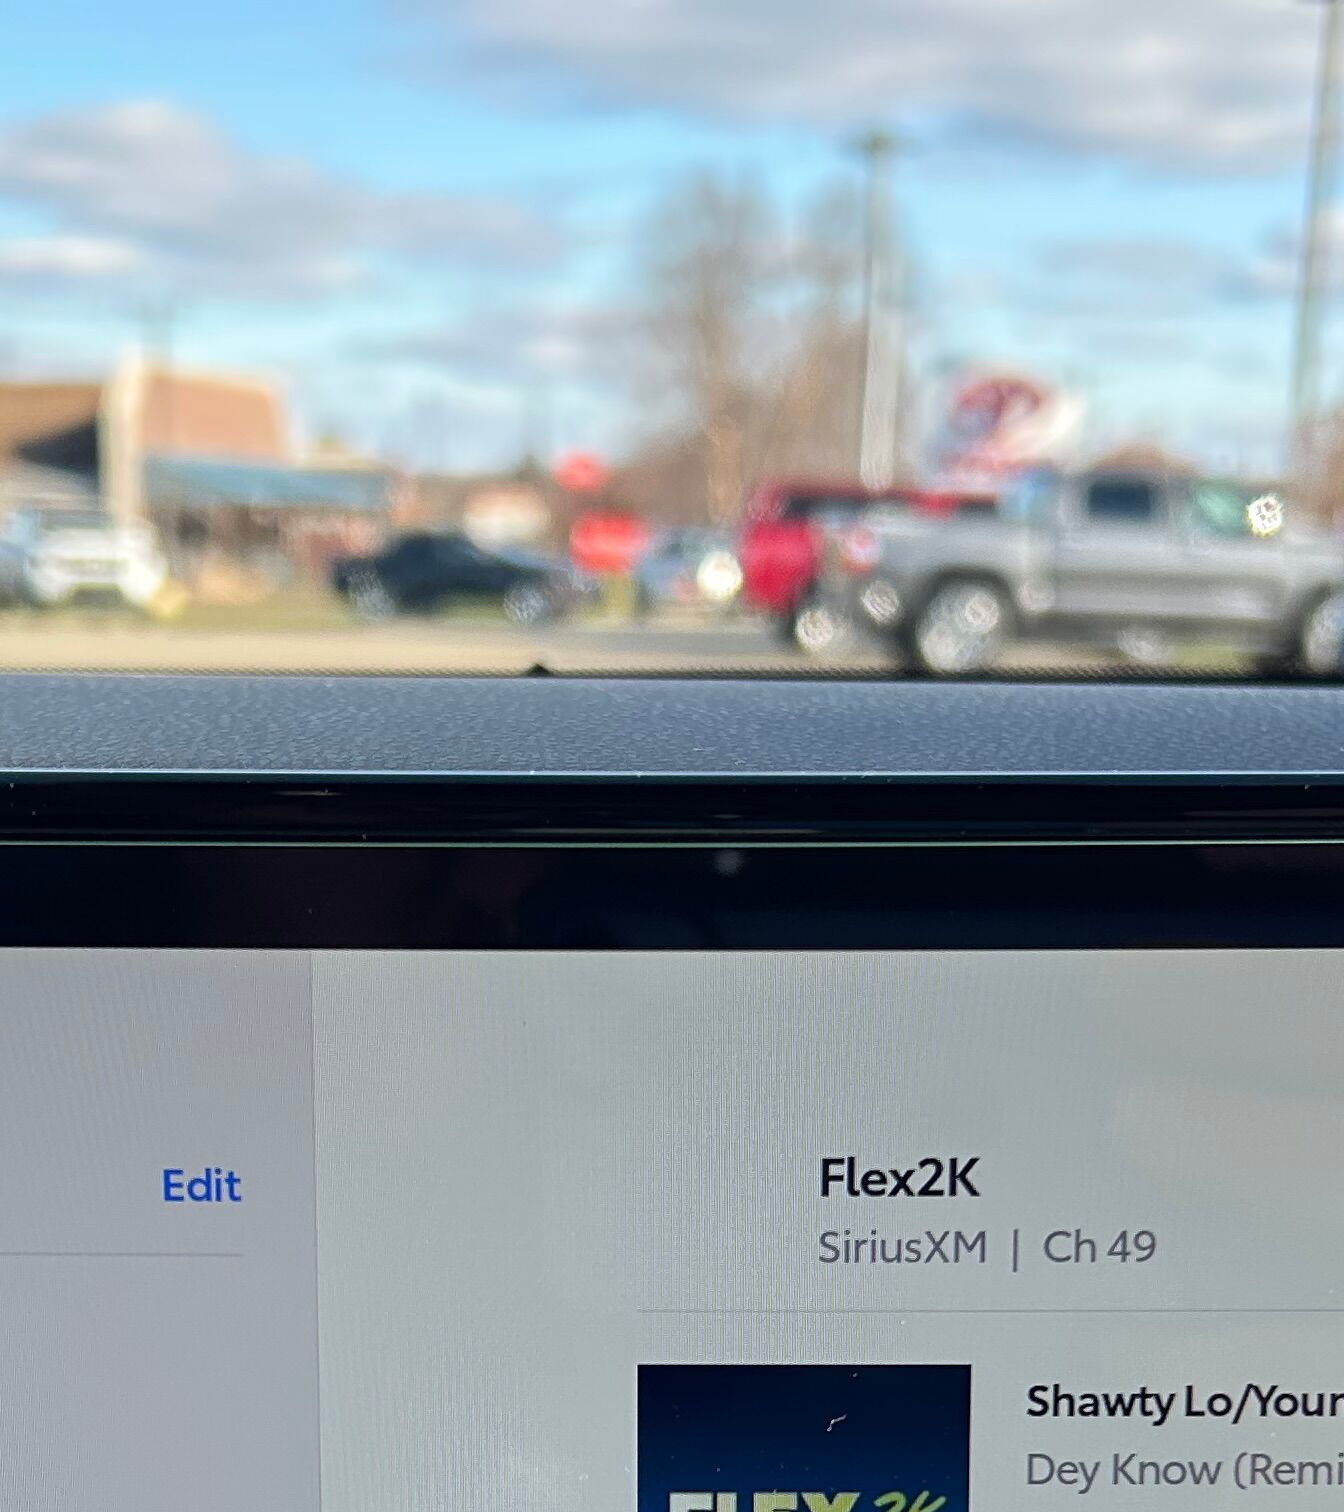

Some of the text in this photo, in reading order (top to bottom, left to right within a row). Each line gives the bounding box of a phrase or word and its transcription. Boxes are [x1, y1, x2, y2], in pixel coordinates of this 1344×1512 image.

[164, 1168, 241, 1202] Edit
[822, 1156, 979, 1197] Flex2K
[819, 1229, 1156, 1263] SiriusXM Ch 49
[1027, 1384, 1175, 1426] Shawty
[1028, 1454, 1100, 1493] Dey
[1113, 1454, 1222, 1485] Know
